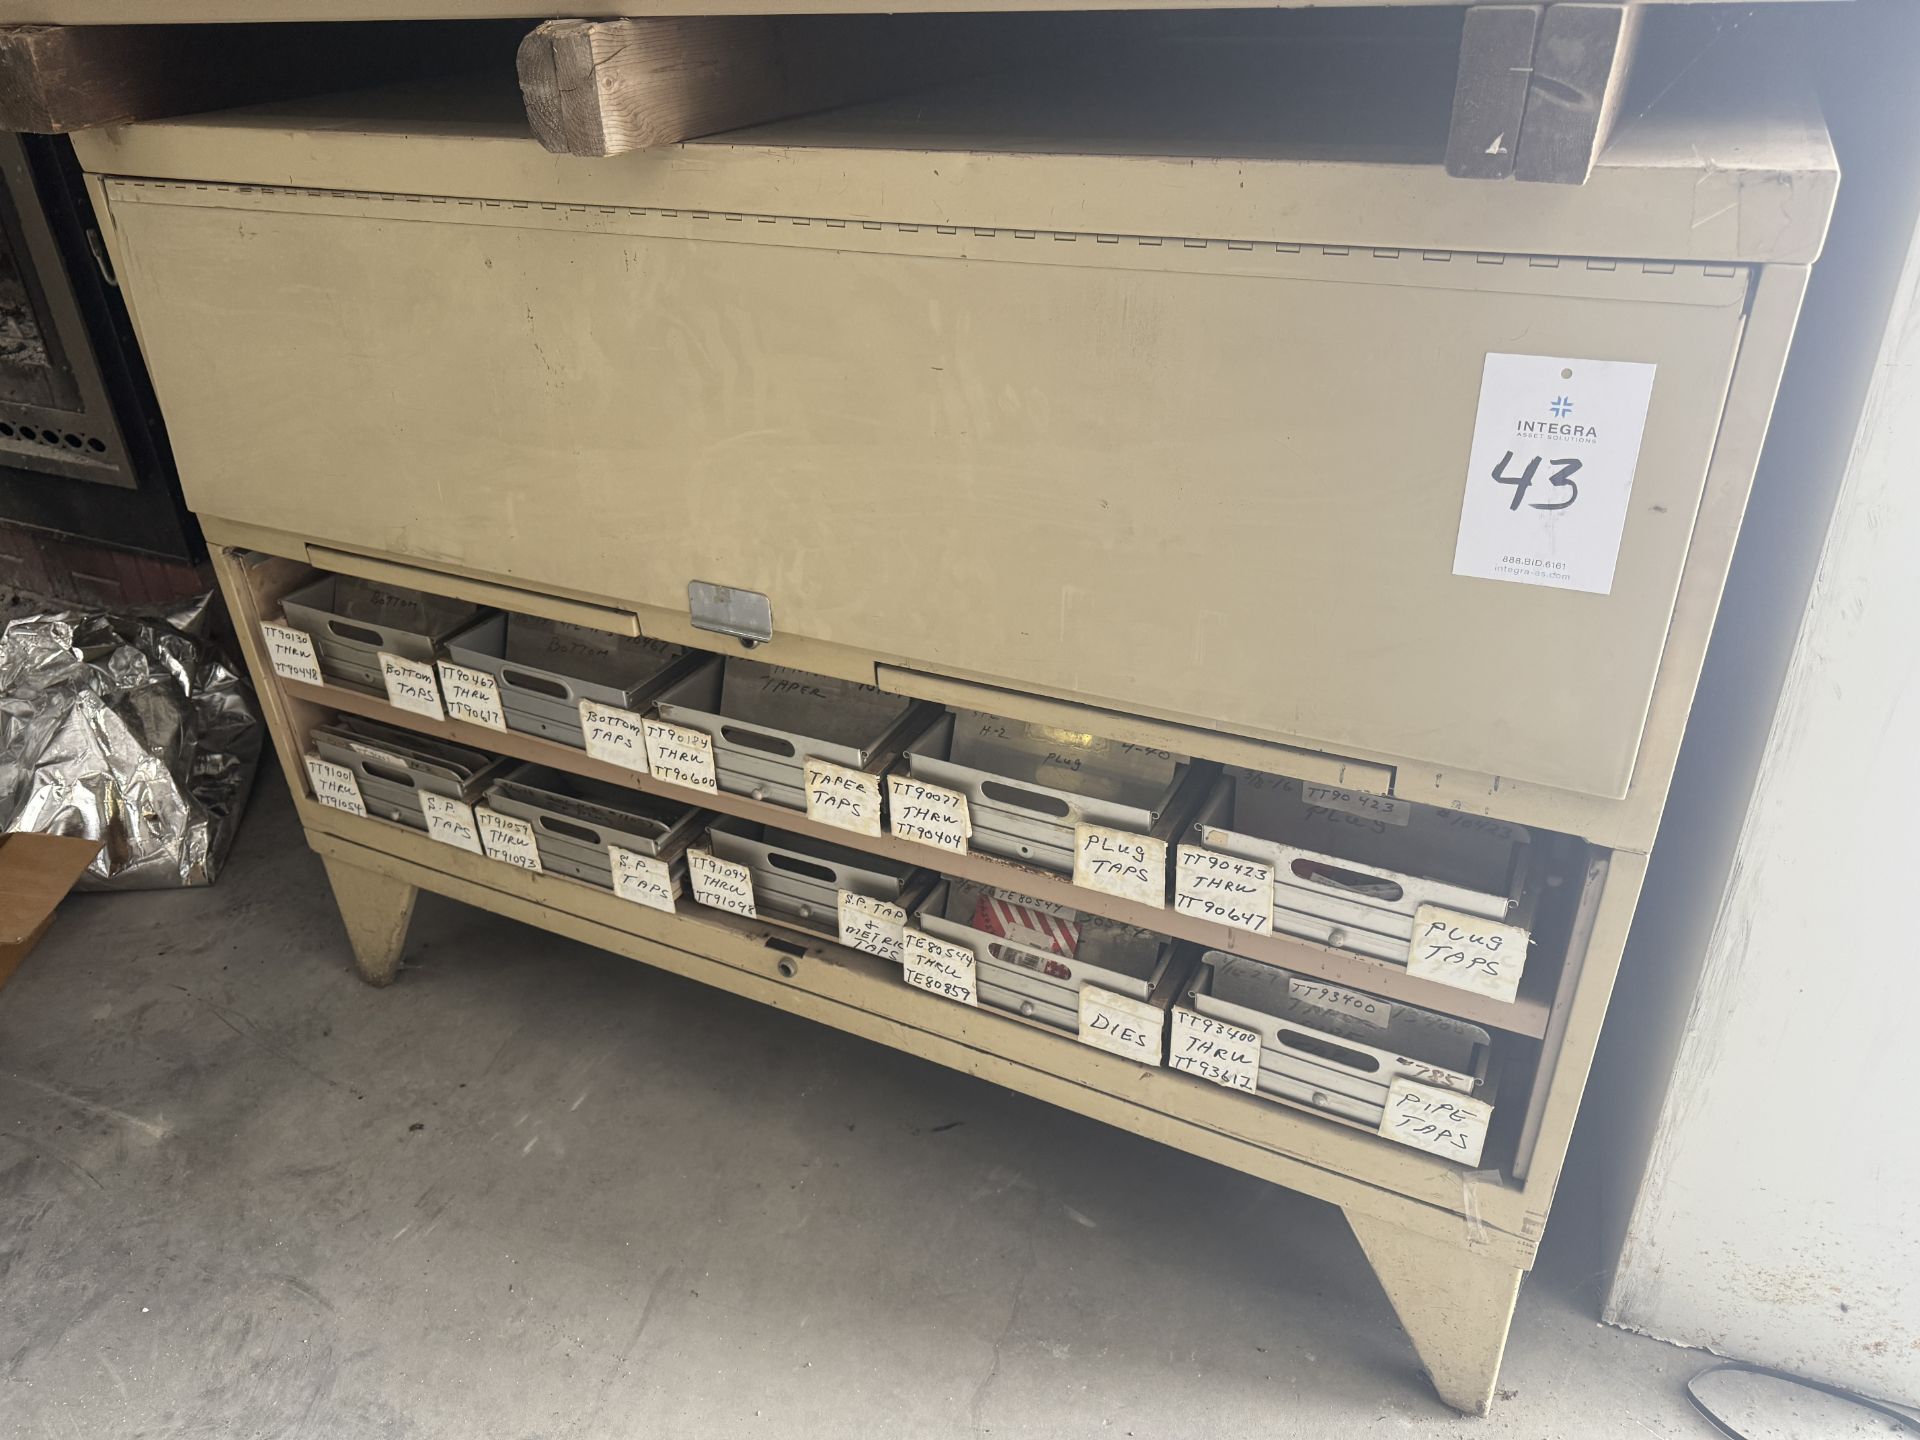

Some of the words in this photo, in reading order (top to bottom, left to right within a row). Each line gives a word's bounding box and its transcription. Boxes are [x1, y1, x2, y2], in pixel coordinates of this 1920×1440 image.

[1517, 420, 1597, 438] INTEGRA
[1547, 434, 1597, 444] SOLUTIONS
[1491, 450, 1583, 511] 43
[1494, 565, 1570, 581] integra-as.com
[1502, 555, 1566, 571] 888.BID.6161
[264, 626, 308, 644] TT90130
[275, 644, 311, 658] THRU
[275, 662, 318, 680] TT90448
[442, 666, 494, 689] TT90467
[397, 682, 434, 702] TAPS
[453, 686, 490, 701] THRU
[760, 675, 827, 699] TAPER
[449, 702, 498, 723] TT90617
[592, 728, 632, 748] TAPS
[659, 747, 704, 764] THRU
[309, 761, 351, 781] TT91001
[655, 765, 715, 788] TT90600
[809, 770, 867, 794] TAPER
[319, 779, 357, 796] THRU
[893, 782, 960, 807] TT90077
[319, 794, 363, 816] TT91054
[813, 790, 861, 817] TAPS
[903, 806, 958, 824] THRU
[432, 816, 471, 839] TAPS
[479, 814, 528, 834] TT91059
[490, 829, 530, 847] THRU
[897, 823, 962, 849] TT90404
[486, 848, 537, 868] TT91093
[692, 857, 748, 882] TT91094
[1183, 853, 1268, 880] TT90423
[1092, 860, 1149, 883] TAPS
[622, 874, 669, 900] TAPS
[703, 875, 748, 896] THRU
[1193, 876, 1256, 893] THRU
[696, 891, 755, 914] TT91098
[1177, 894, 1267, 931] TT90647
[854, 937, 899, 961] TAPS
[906, 934, 973, 968] TE80544
[1424, 945, 1500, 976] TAPS
[906, 968, 971, 1001] TE80859
[1293, 982, 1375, 1013] TT93400
[1090, 1013, 1147, 1047] DIES
[1178, 1011, 1256, 1042] TT93400
[1185, 1036, 1252, 1064] THRU
[1175, 1054, 1252, 1090] TT93612
[1396, 1093, 1477, 1122] PIPE
[1396, 1114, 1468, 1149] TAPS
